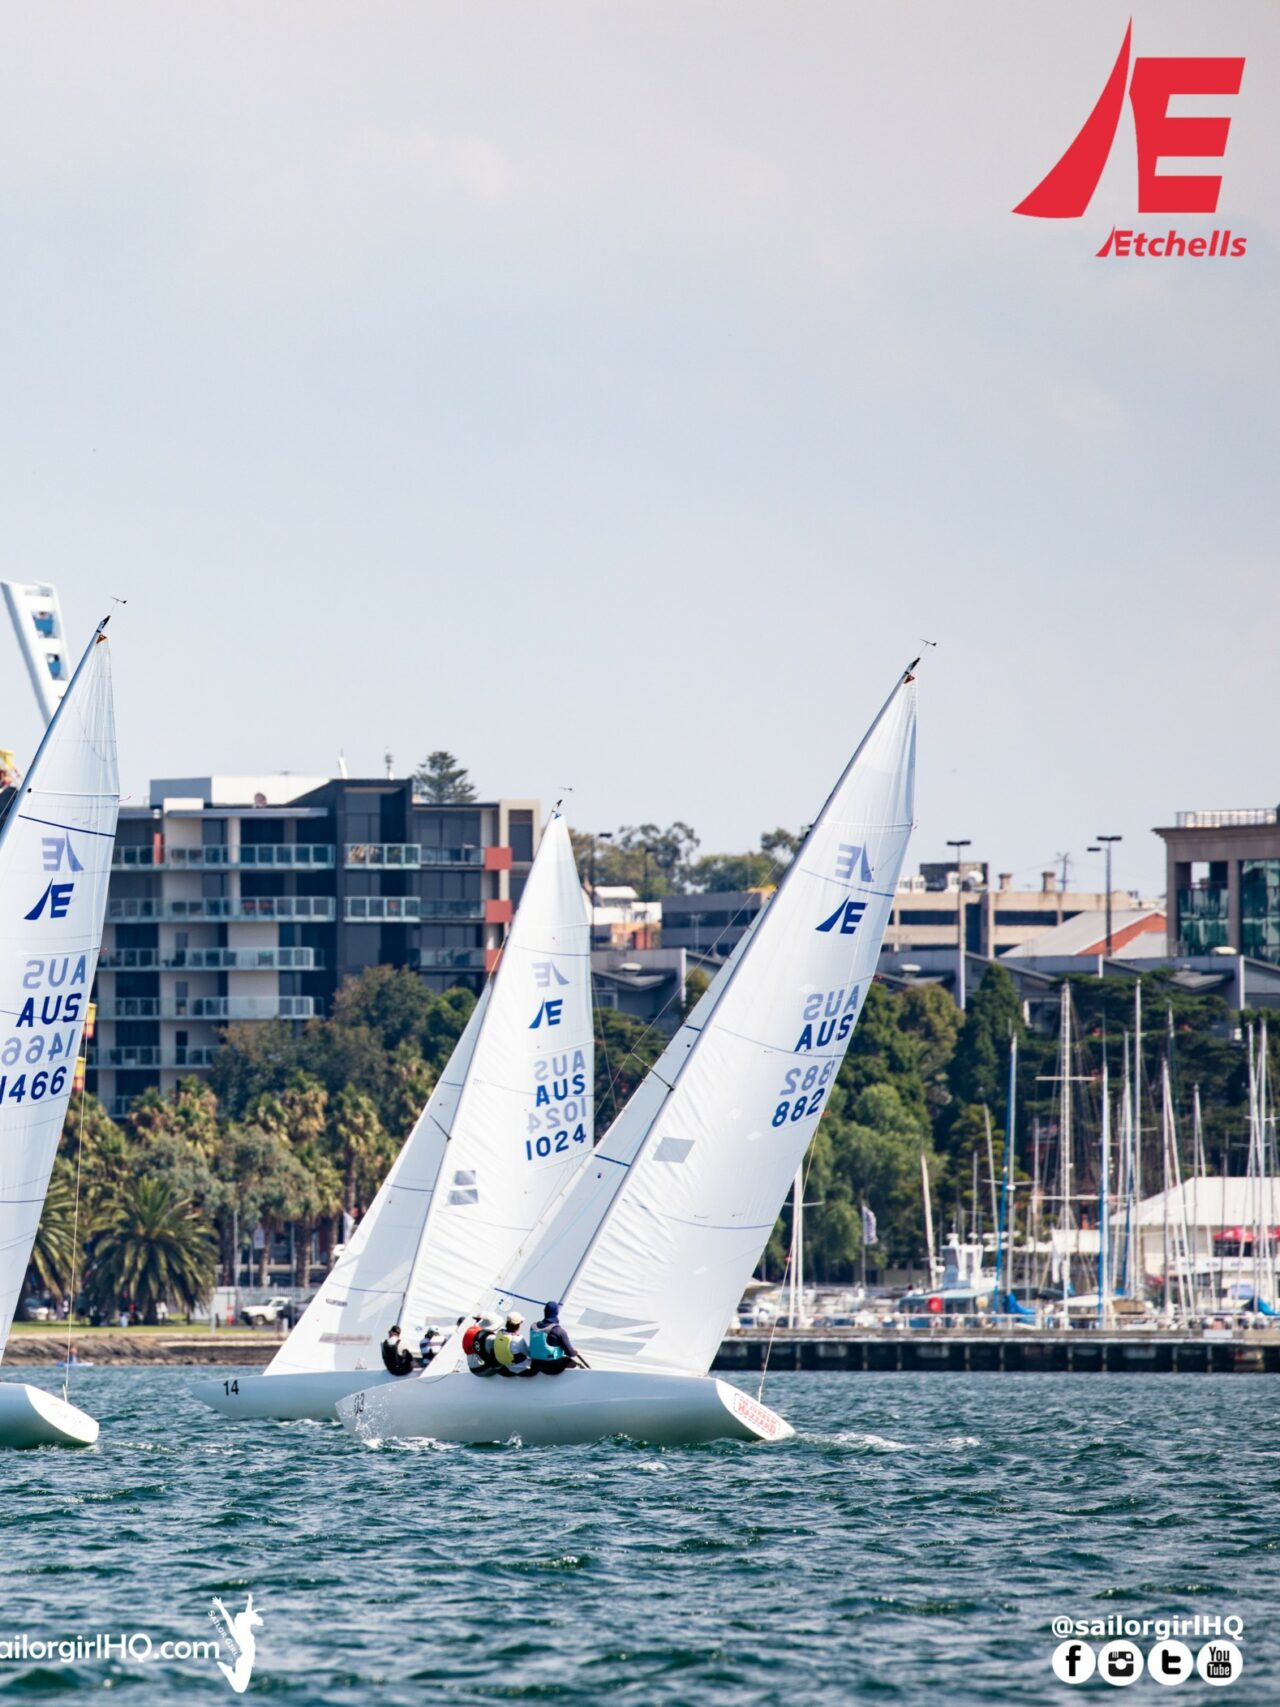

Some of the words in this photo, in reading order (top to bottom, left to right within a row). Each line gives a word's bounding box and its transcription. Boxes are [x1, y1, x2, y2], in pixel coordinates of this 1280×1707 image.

[16, 993, 81, 1027] AUS
[794, 1014, 854, 1052] AUS
[536, 1074, 585, 1107] AUS
[771, 1087, 825, 1128] 882
[526, 1123, 586, 1161] 1024
[223, 1379, 240, 1396] 14
